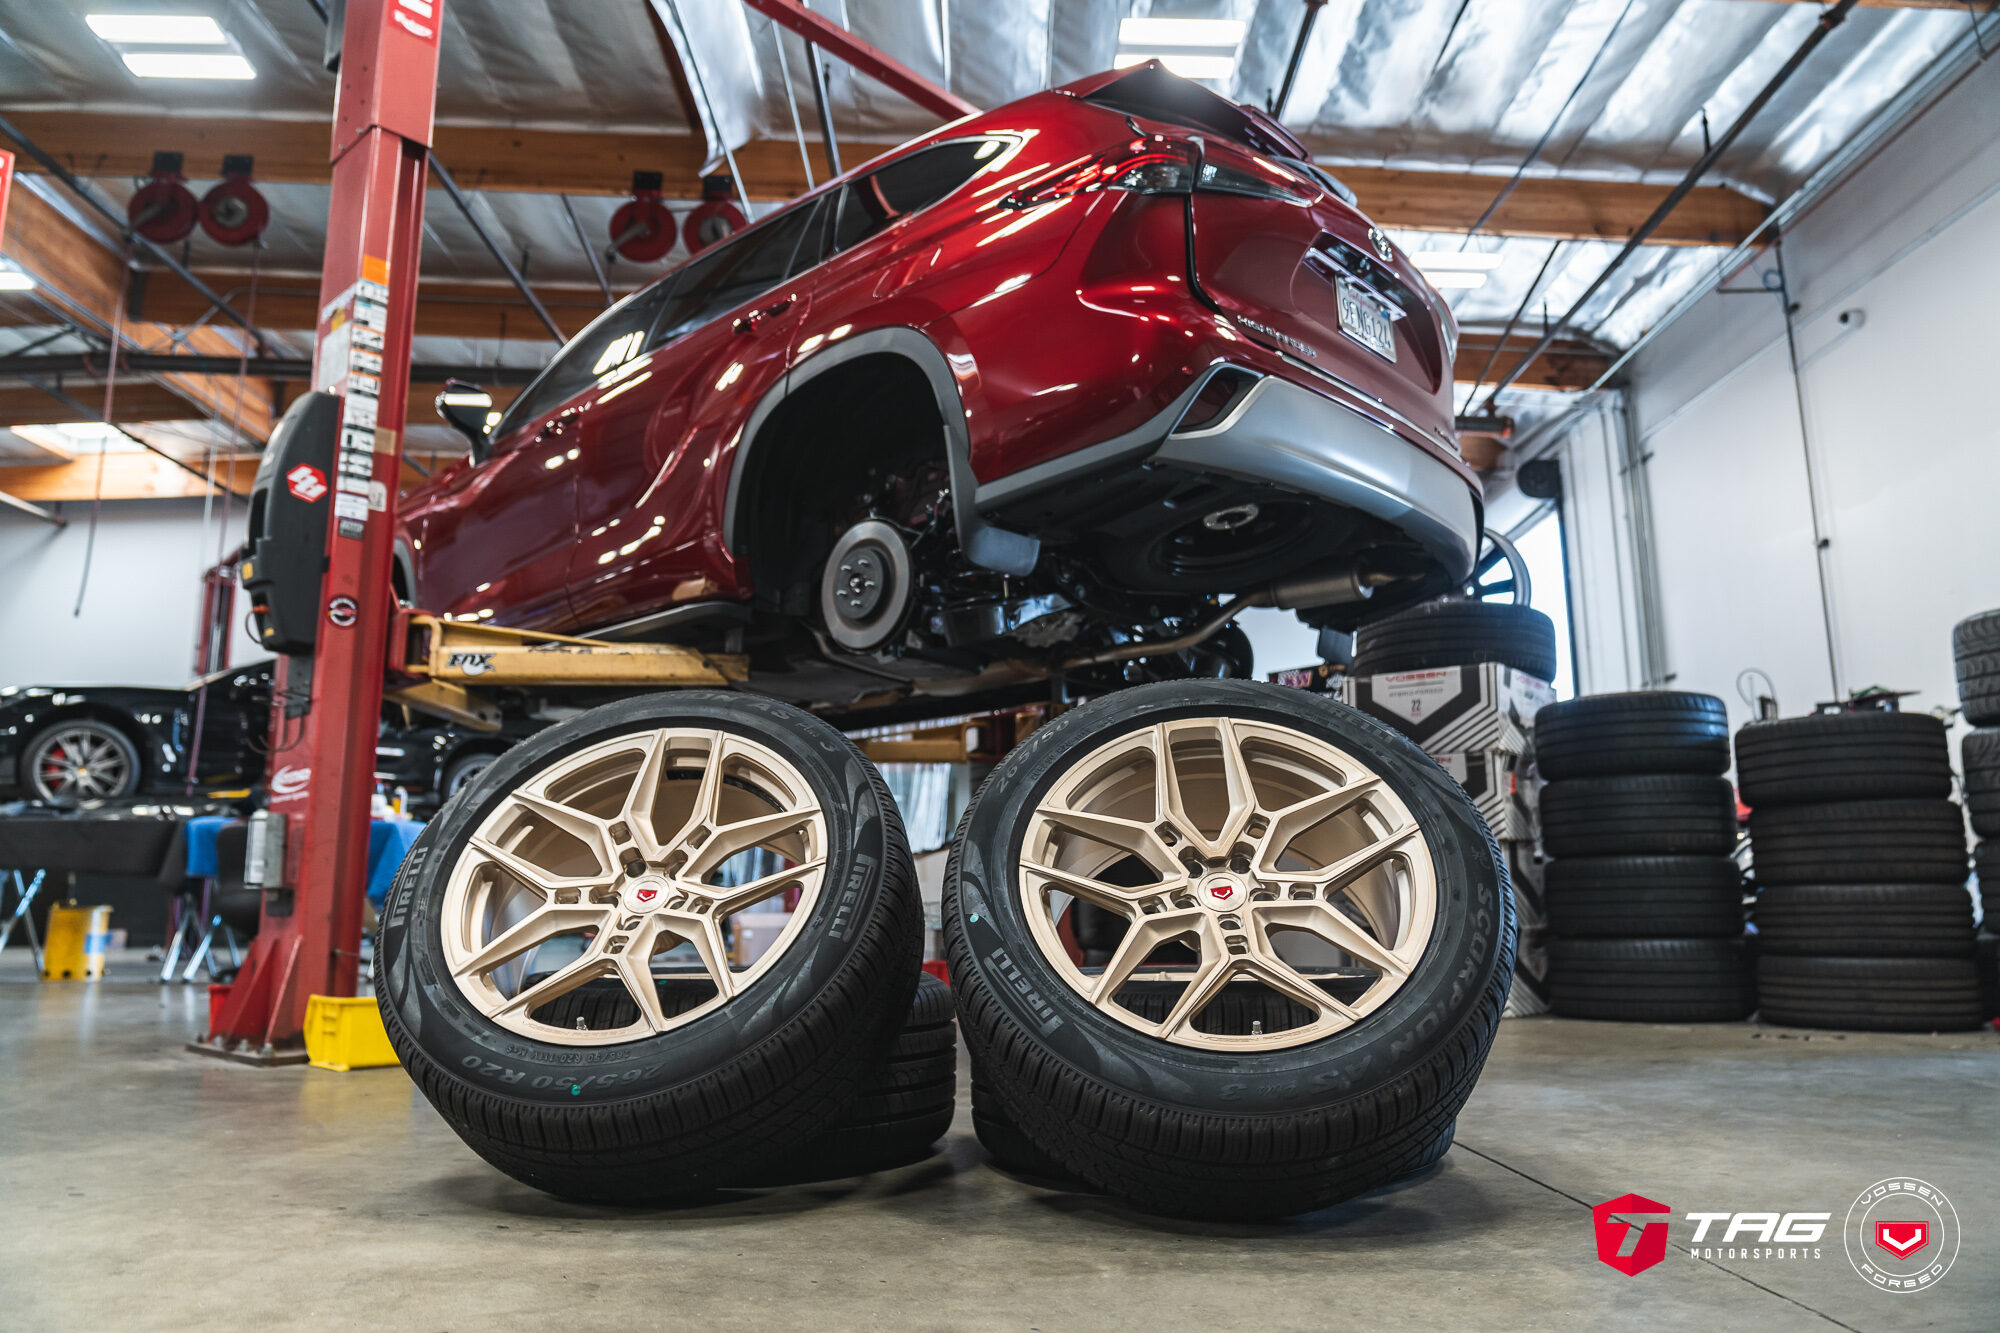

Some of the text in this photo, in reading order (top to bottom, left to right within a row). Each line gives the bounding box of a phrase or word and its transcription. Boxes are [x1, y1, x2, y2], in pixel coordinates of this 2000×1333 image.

[1385, 671, 1447, 682] VOSSEN
[1411, 699, 1421, 712] 22
[386, 846, 429, 929] PIRELLI
[828, 853, 879, 942] PIRELLI
[983, 947, 1064, 1038] PIRELLI
[461, 1054, 667, 1091] 265/50 R20
